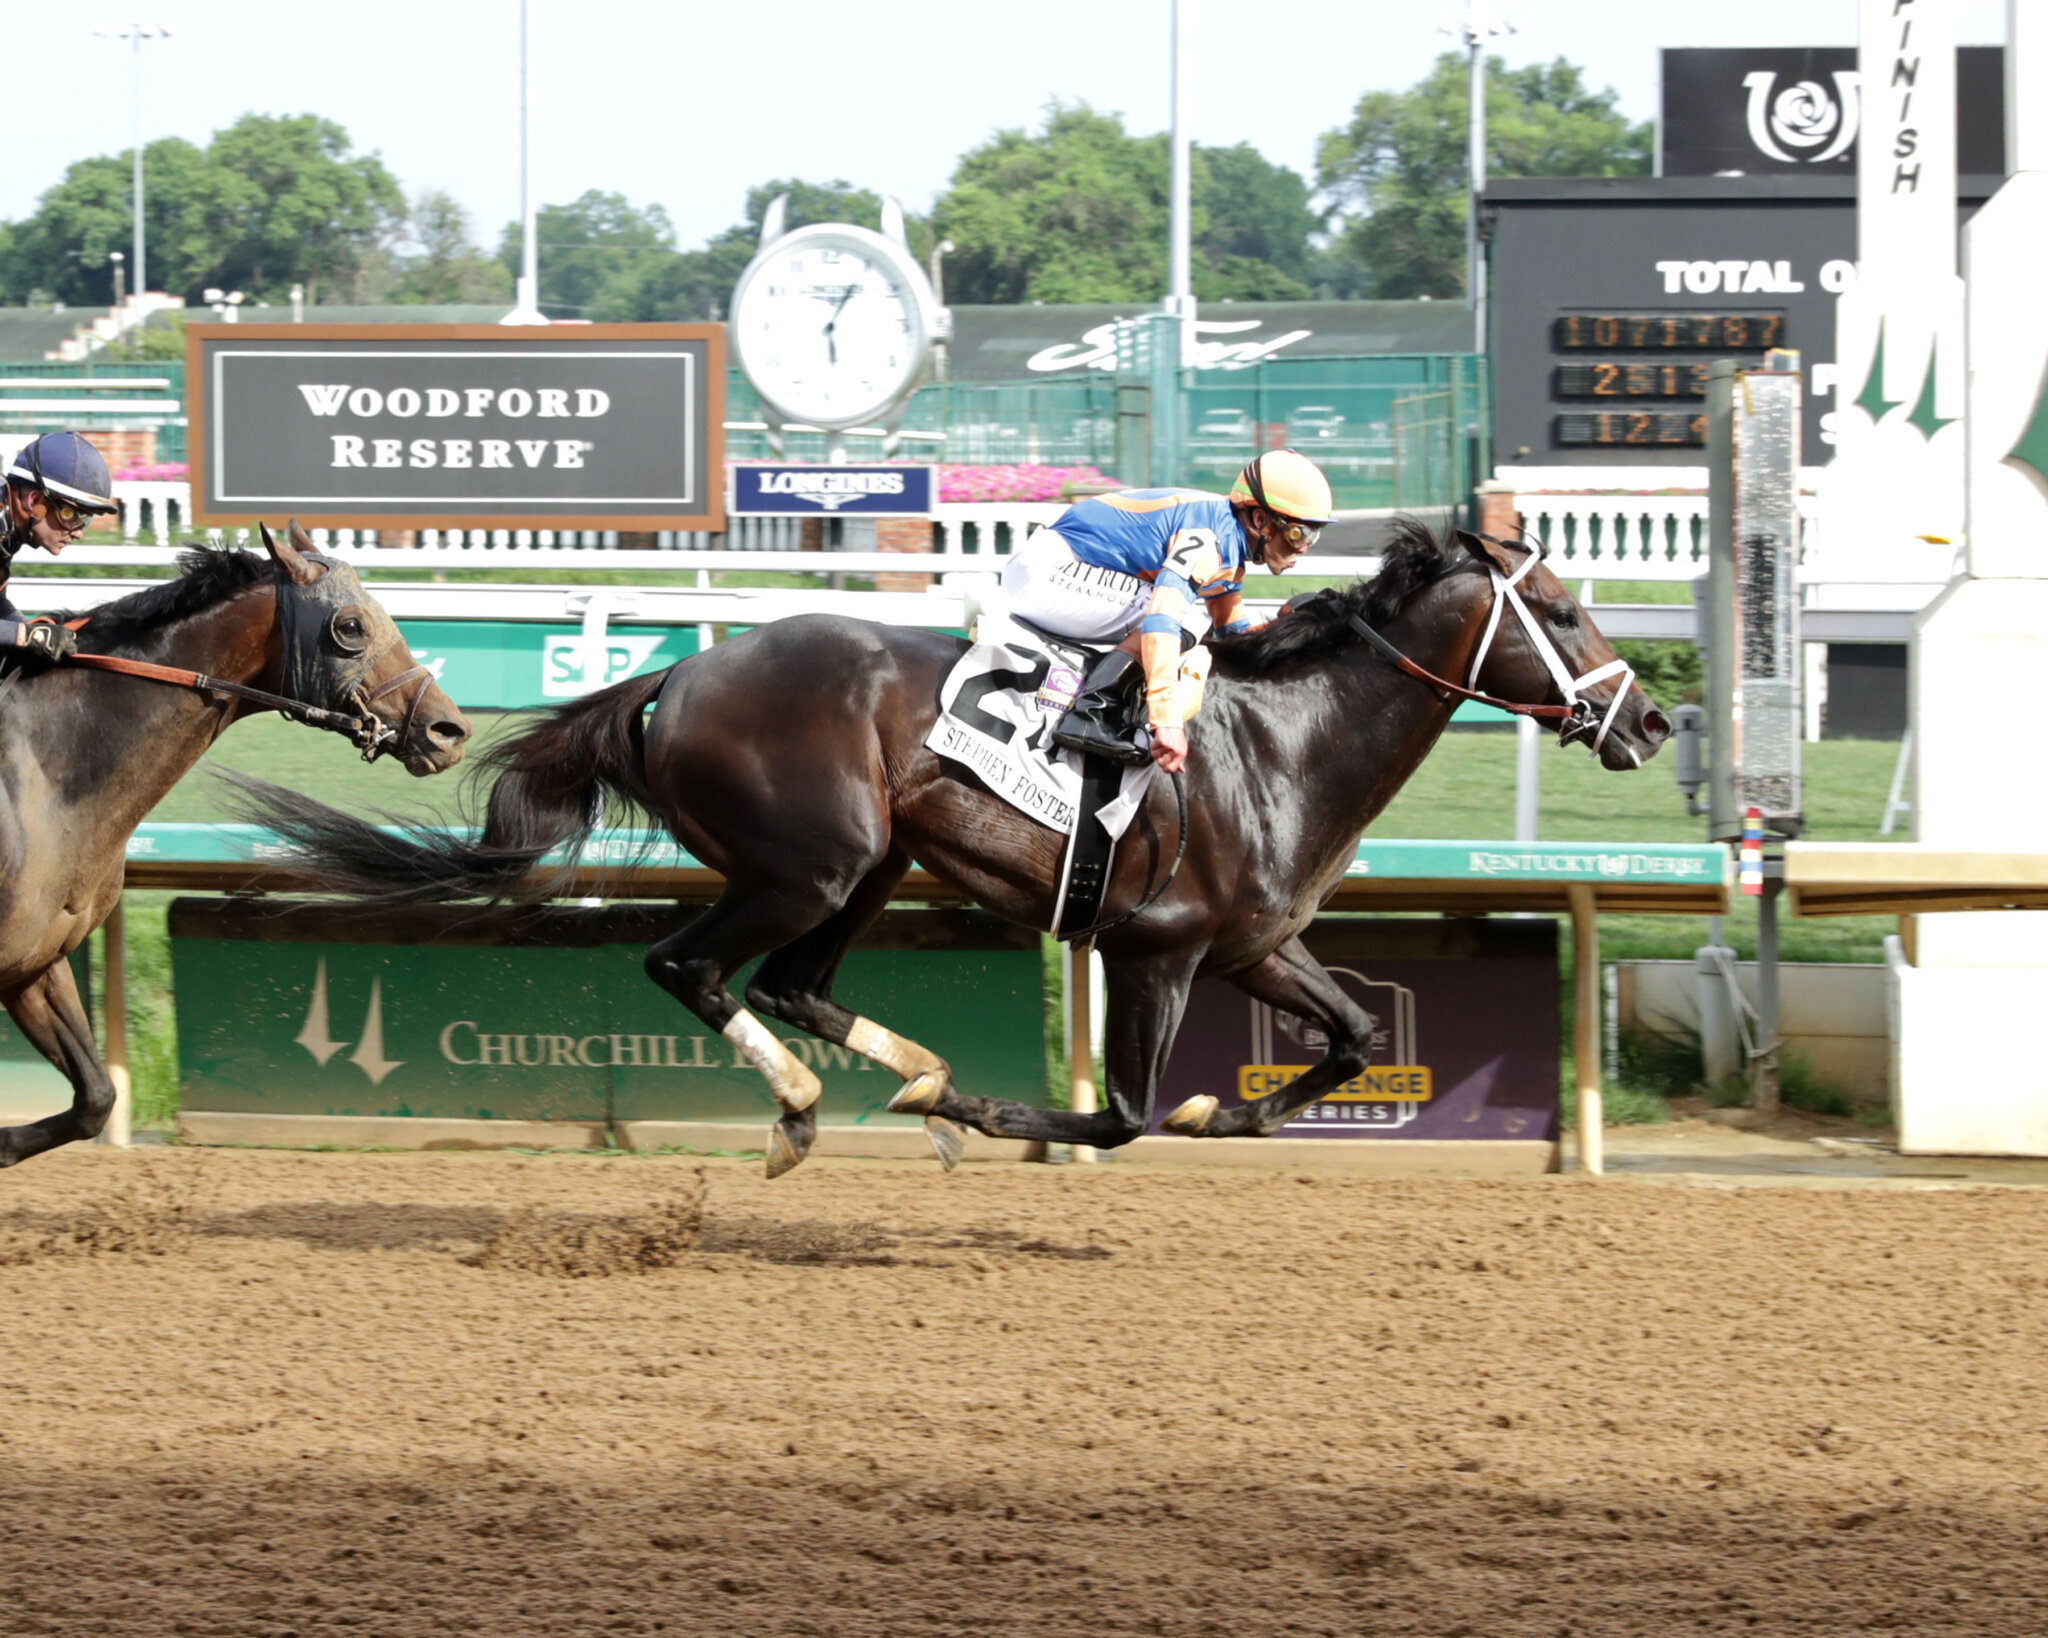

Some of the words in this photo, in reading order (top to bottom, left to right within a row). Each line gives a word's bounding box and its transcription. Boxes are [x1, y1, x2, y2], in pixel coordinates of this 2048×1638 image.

[1655, 260, 1805, 294] TOTAL
[297, 384, 611, 418] WOODFORD
[330, 434, 586, 469] RESERVE
[758, 472, 905, 494] LONGINES
[1172, 536, 1204, 566] 2
[1049, 574, 1147, 611] STEAKHOUSE
[551, 646, 631, 683] SP
[943, 727, 1013, 785] STEPHEN
[1011, 775, 1076, 828] FOSTER
[1469, 852, 1598, 874] KENTUCKY
[439, 1020, 722, 1069] CHURCHILL
[1247, 1072, 1424, 1094] CHENGE
[1294, 1104, 1389, 1120] ERIES
